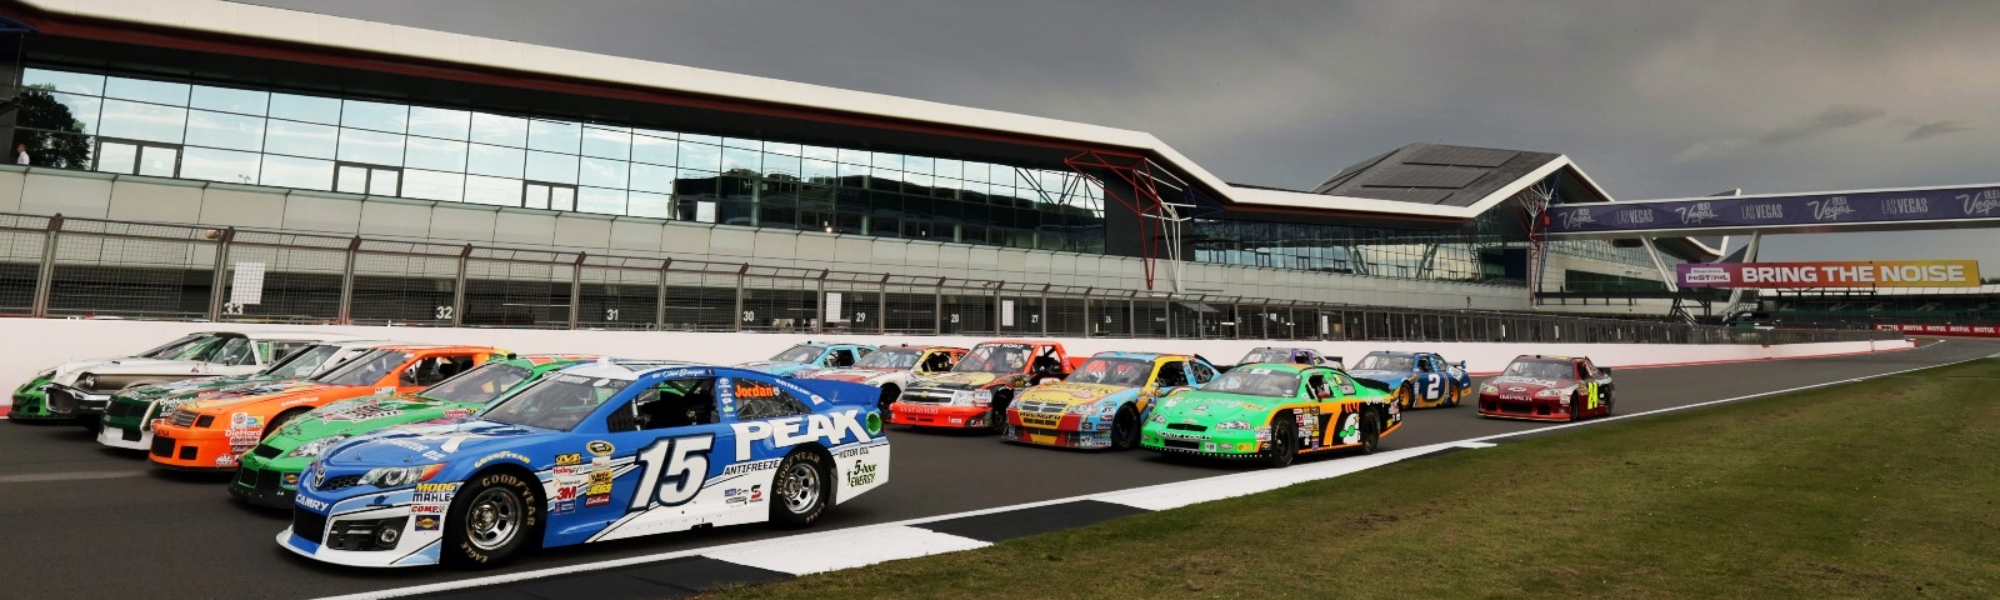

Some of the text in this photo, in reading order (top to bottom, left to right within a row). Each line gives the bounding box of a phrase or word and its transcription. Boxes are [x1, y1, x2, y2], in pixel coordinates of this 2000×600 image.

[1675, 205, 1718, 225] Vegas
[1807, 199, 1855, 220] Vegas
[1742, 265, 1966, 282] BRING THE NOISE
[436, 306, 453, 319] 32
[607, 309, 619, 321] 31
[743, 311, 754, 321] 30
[856, 312, 866, 322] 29
[735, 384, 773, 398] Jordan
[1427, 374, 1440, 400] 2
[225, 428, 262, 437] DieHard
[1320, 402, 1343, 446] 7
[730, 409, 872, 462] PEAK
[475, 451, 531, 468] GOODYEAR
[839, 448, 859, 459] MOTOR
[628, 433, 714, 512] 15
[724, 459, 780, 476] ANTIFREEZE
[776, 451, 821, 495] GOODYEAR
[415, 483, 456, 492] MOOG
[850, 473, 876, 488] ENERGY
[412, 493, 451, 502] MAHLE
[482, 474, 536, 526] GOODYEAR
[557, 486, 578, 500] 3M
[296, 494, 329, 511] CAMRY
[461, 541, 489, 563] EAGLE
